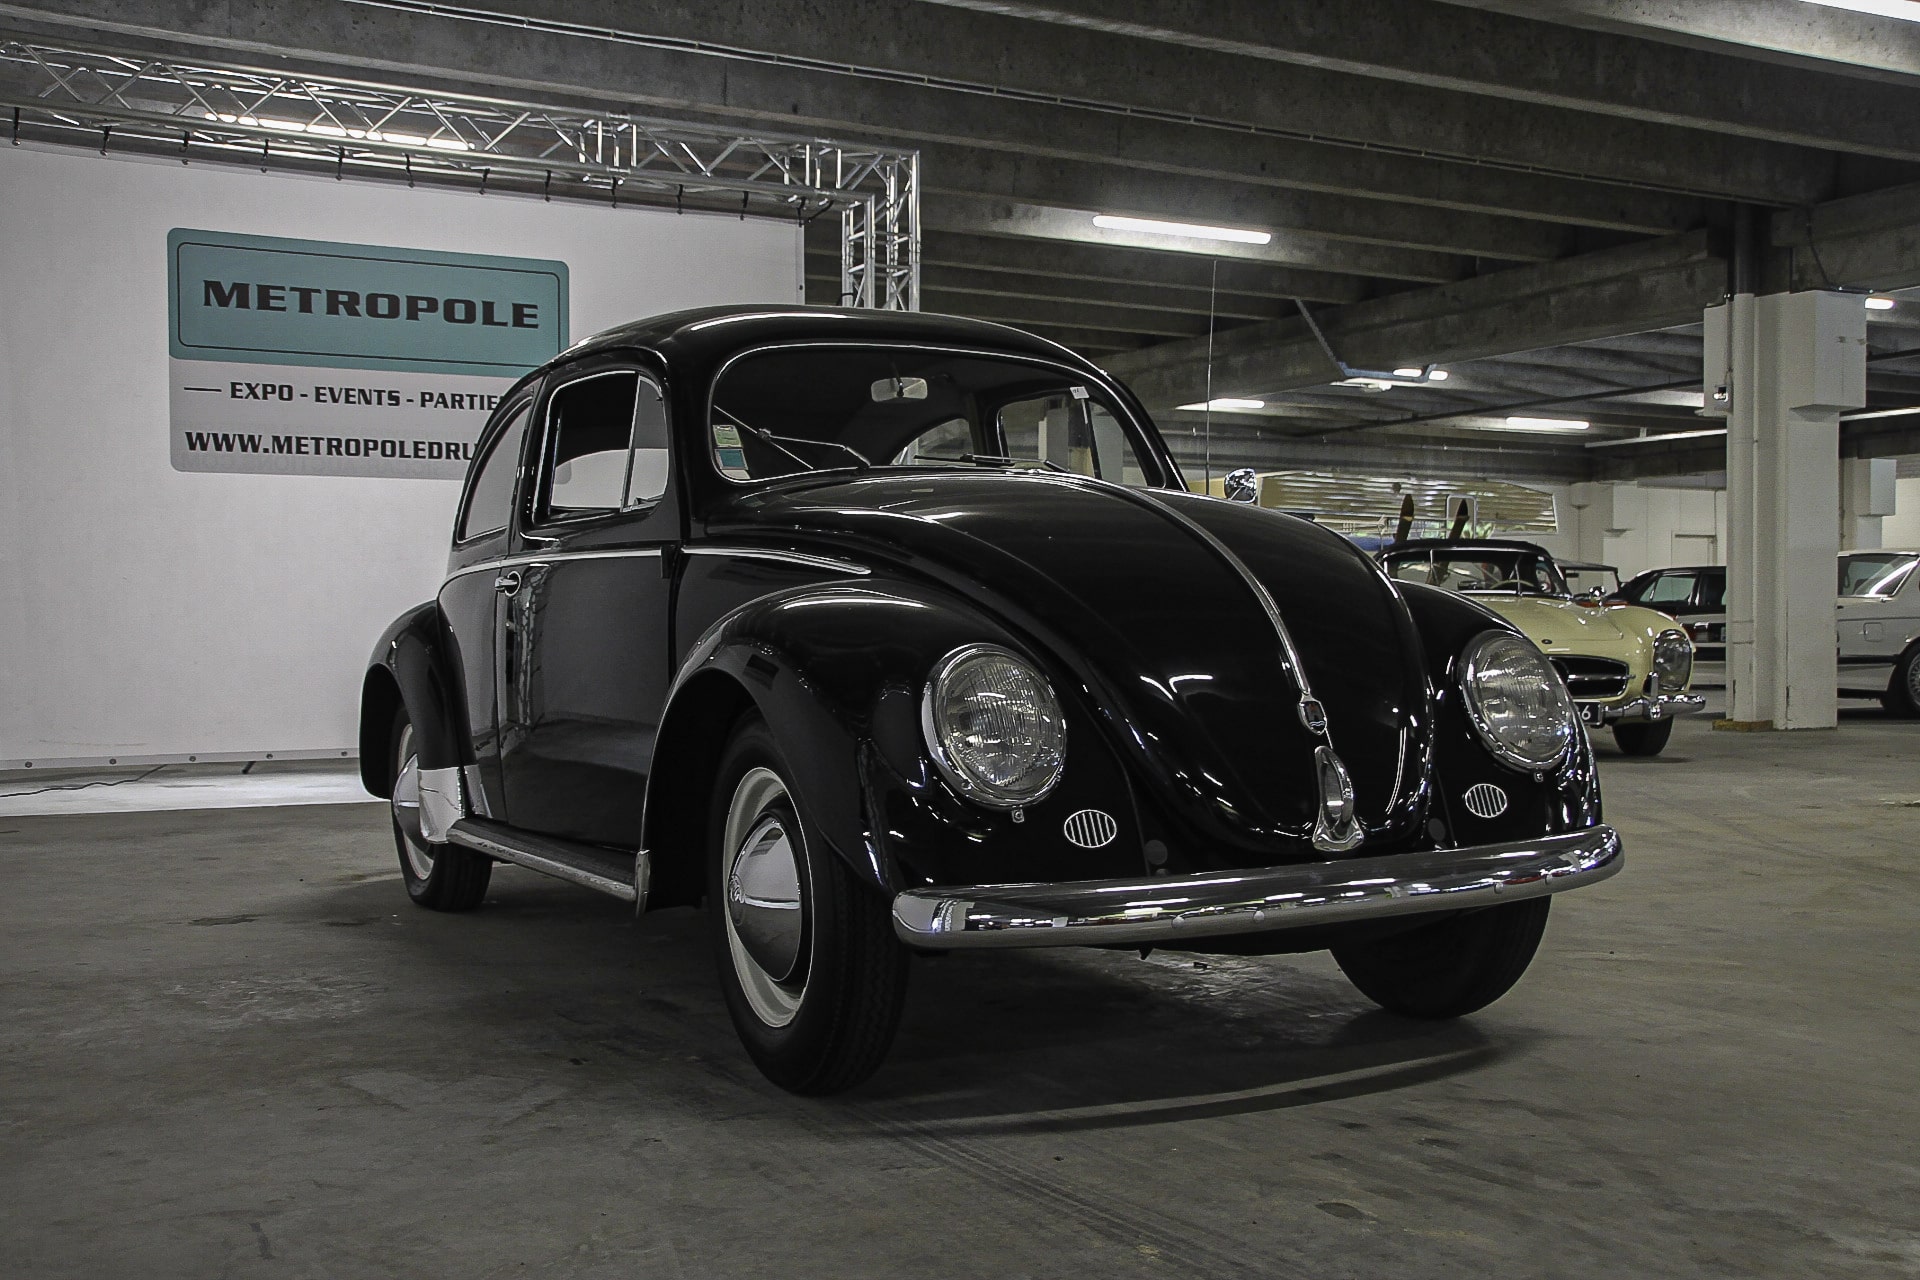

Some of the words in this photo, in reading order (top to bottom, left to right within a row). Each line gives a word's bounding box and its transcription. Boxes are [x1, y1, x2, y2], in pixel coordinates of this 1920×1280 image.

[202, 279, 539, 329] METROPOLE
[230, 381, 294, 402] EXPO
[314, 386, 401, 407] EVENTS
[420, 391, 502, 410] PARTIE
